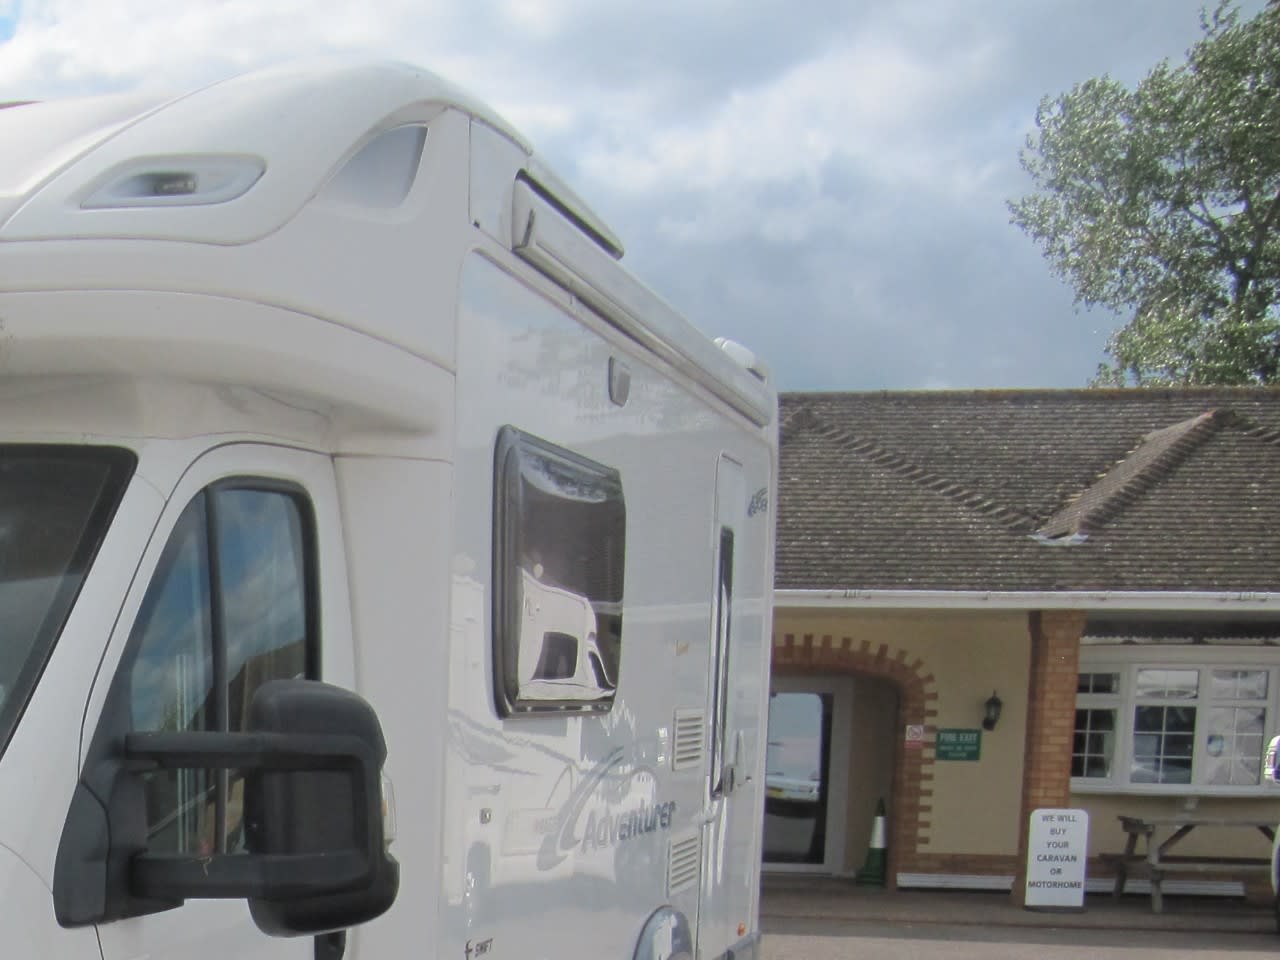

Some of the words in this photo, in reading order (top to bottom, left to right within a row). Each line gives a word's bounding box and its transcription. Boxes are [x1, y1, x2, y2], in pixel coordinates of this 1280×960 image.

[1041, 815, 1055, 823] WE
[1057, 815, 1077, 823] WILL
[1046, 841, 1069, 849] YOUR
[1036, 854, 1077, 863] CARAVAN
[1049, 867, 1062, 875] OR
[1028, 881, 1082, 889] MOTORHOME
